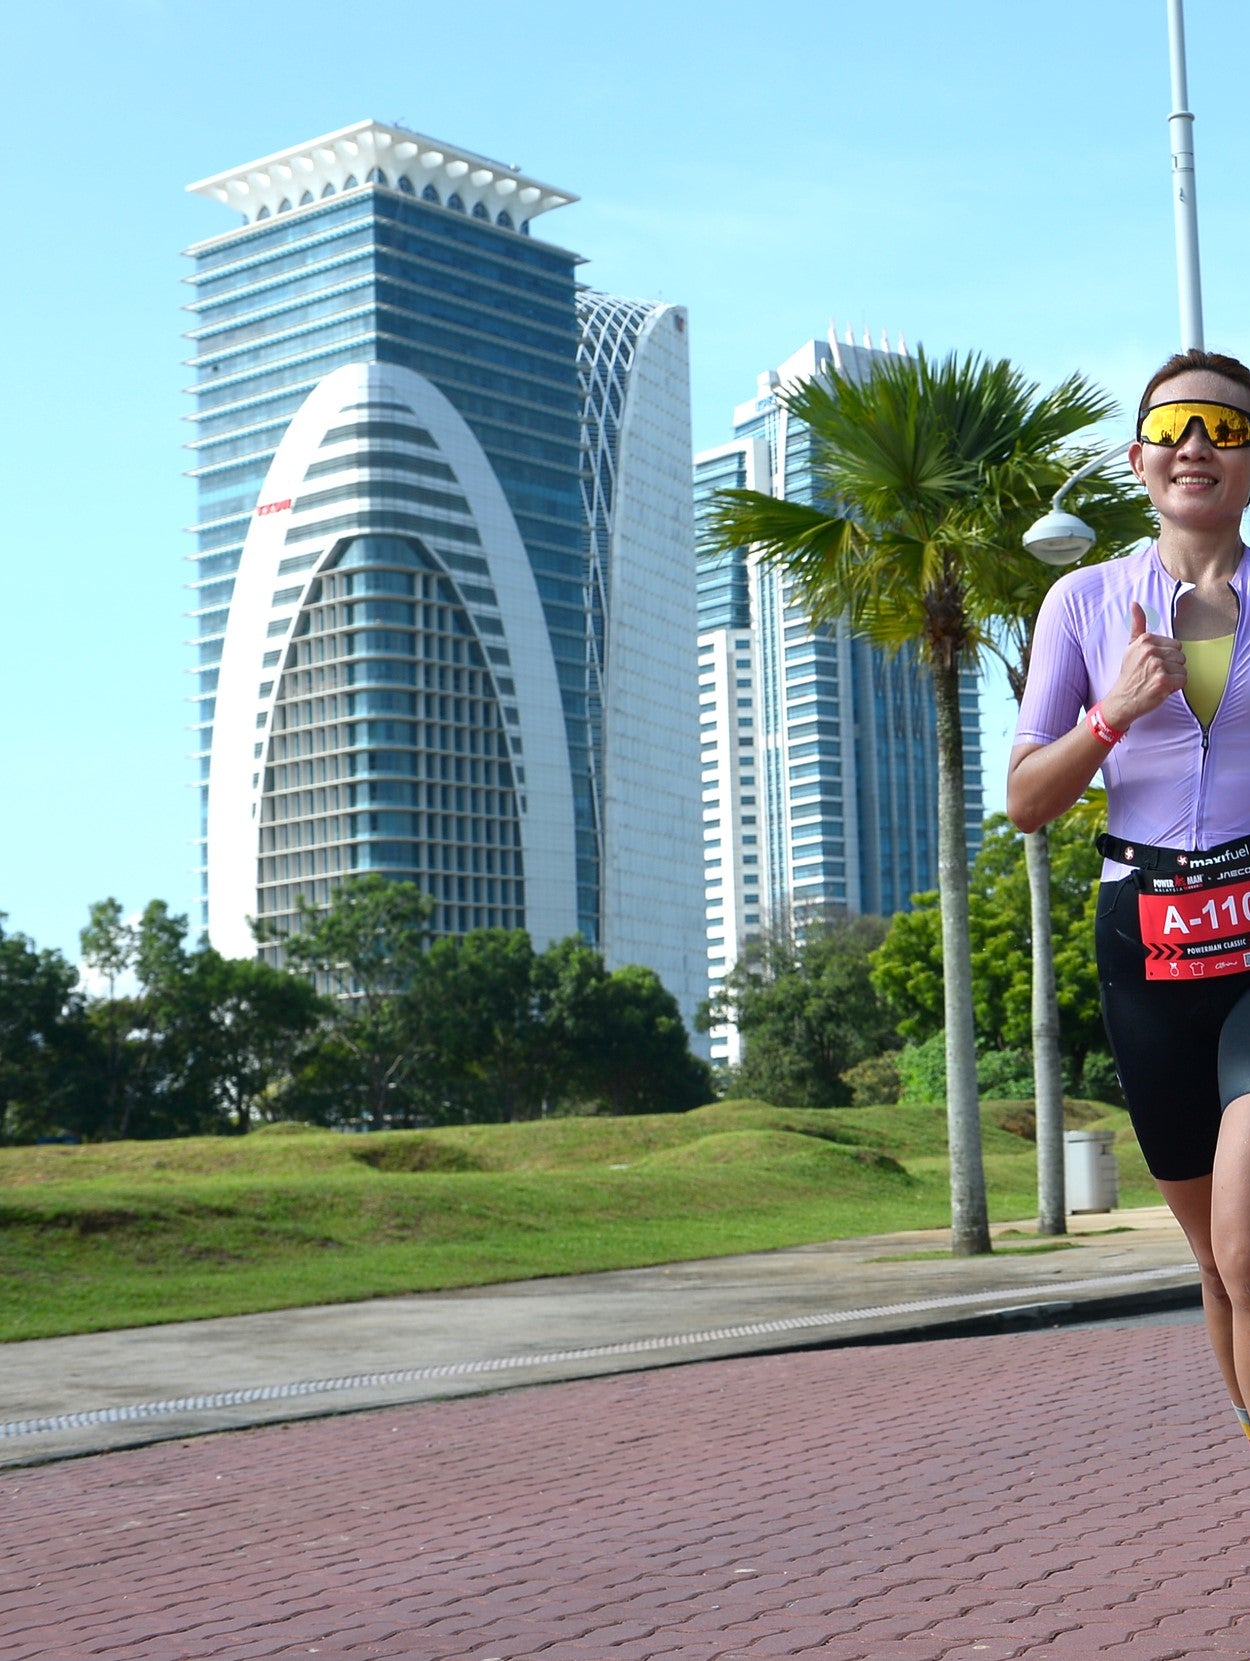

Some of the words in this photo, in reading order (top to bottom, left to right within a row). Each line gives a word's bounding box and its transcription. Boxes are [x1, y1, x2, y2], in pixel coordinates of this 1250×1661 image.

[1190, 844, 1250, 868] maxifuel
[1153, 879, 1174, 887] POWER
[1187, 875, 1203, 885] MAN
[1187, 944, 1222, 954] POWERMAN
[1223, 939, 1247, 949] CLASSIC
